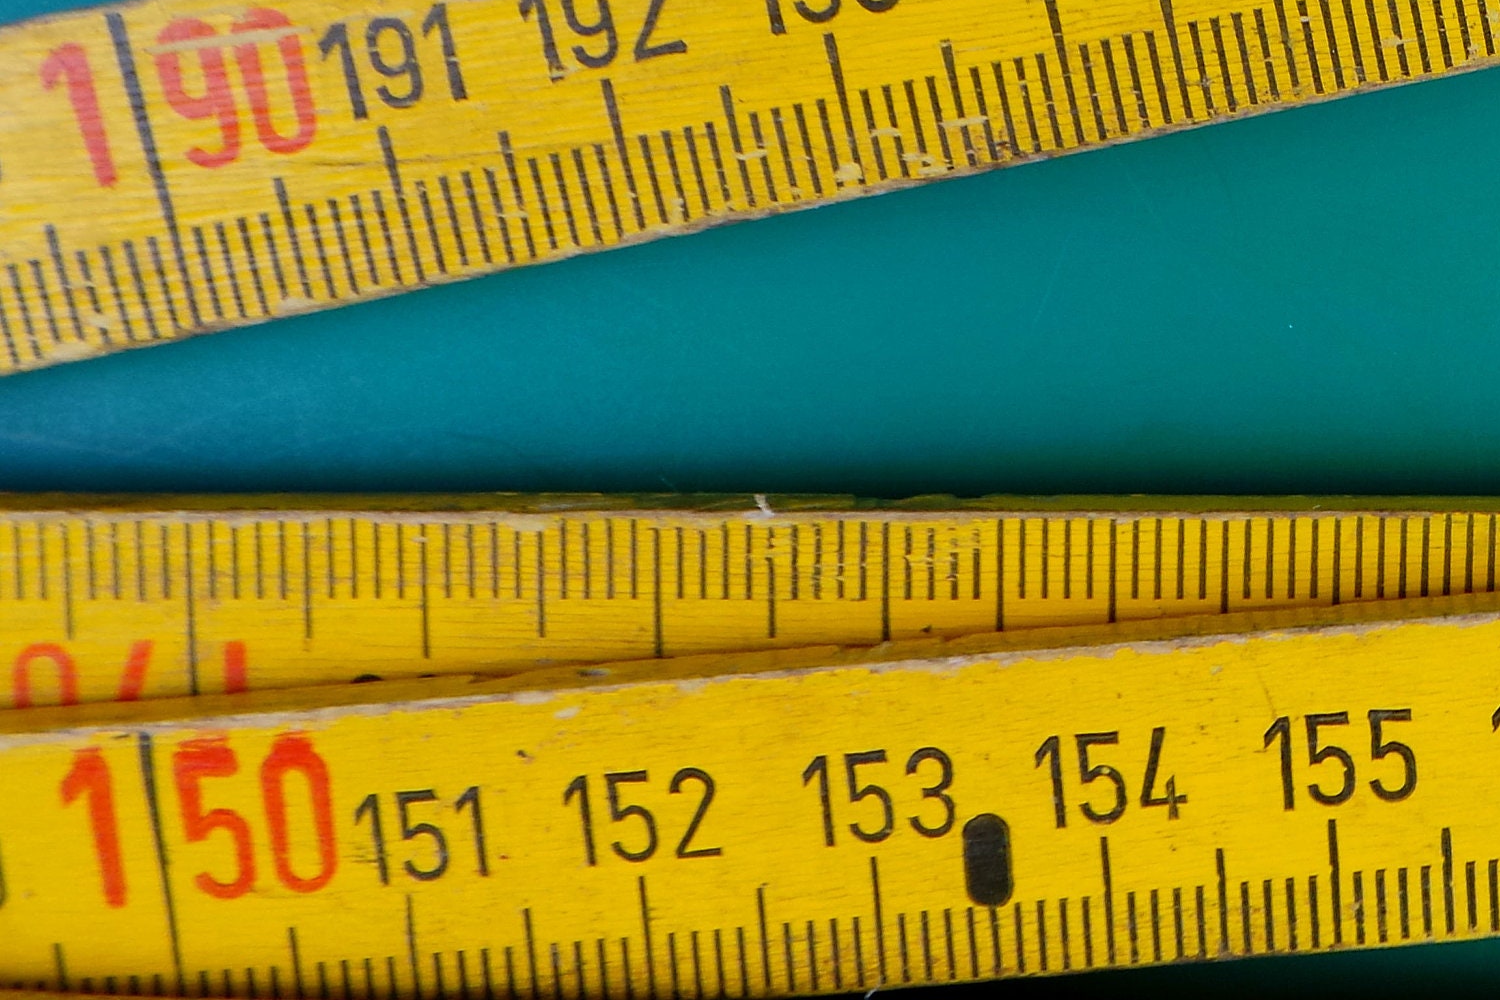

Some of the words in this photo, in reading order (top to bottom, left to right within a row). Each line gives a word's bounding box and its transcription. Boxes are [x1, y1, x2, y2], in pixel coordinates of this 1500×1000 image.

[319, 2, 468, 119] 191
[354, 785, 489, 886] 151
[563, 767, 723, 867] 152
[802, 747, 956, 847] 153
[1034, 726, 1188, 829] 154
[1263, 708, 1419, 812] 155
